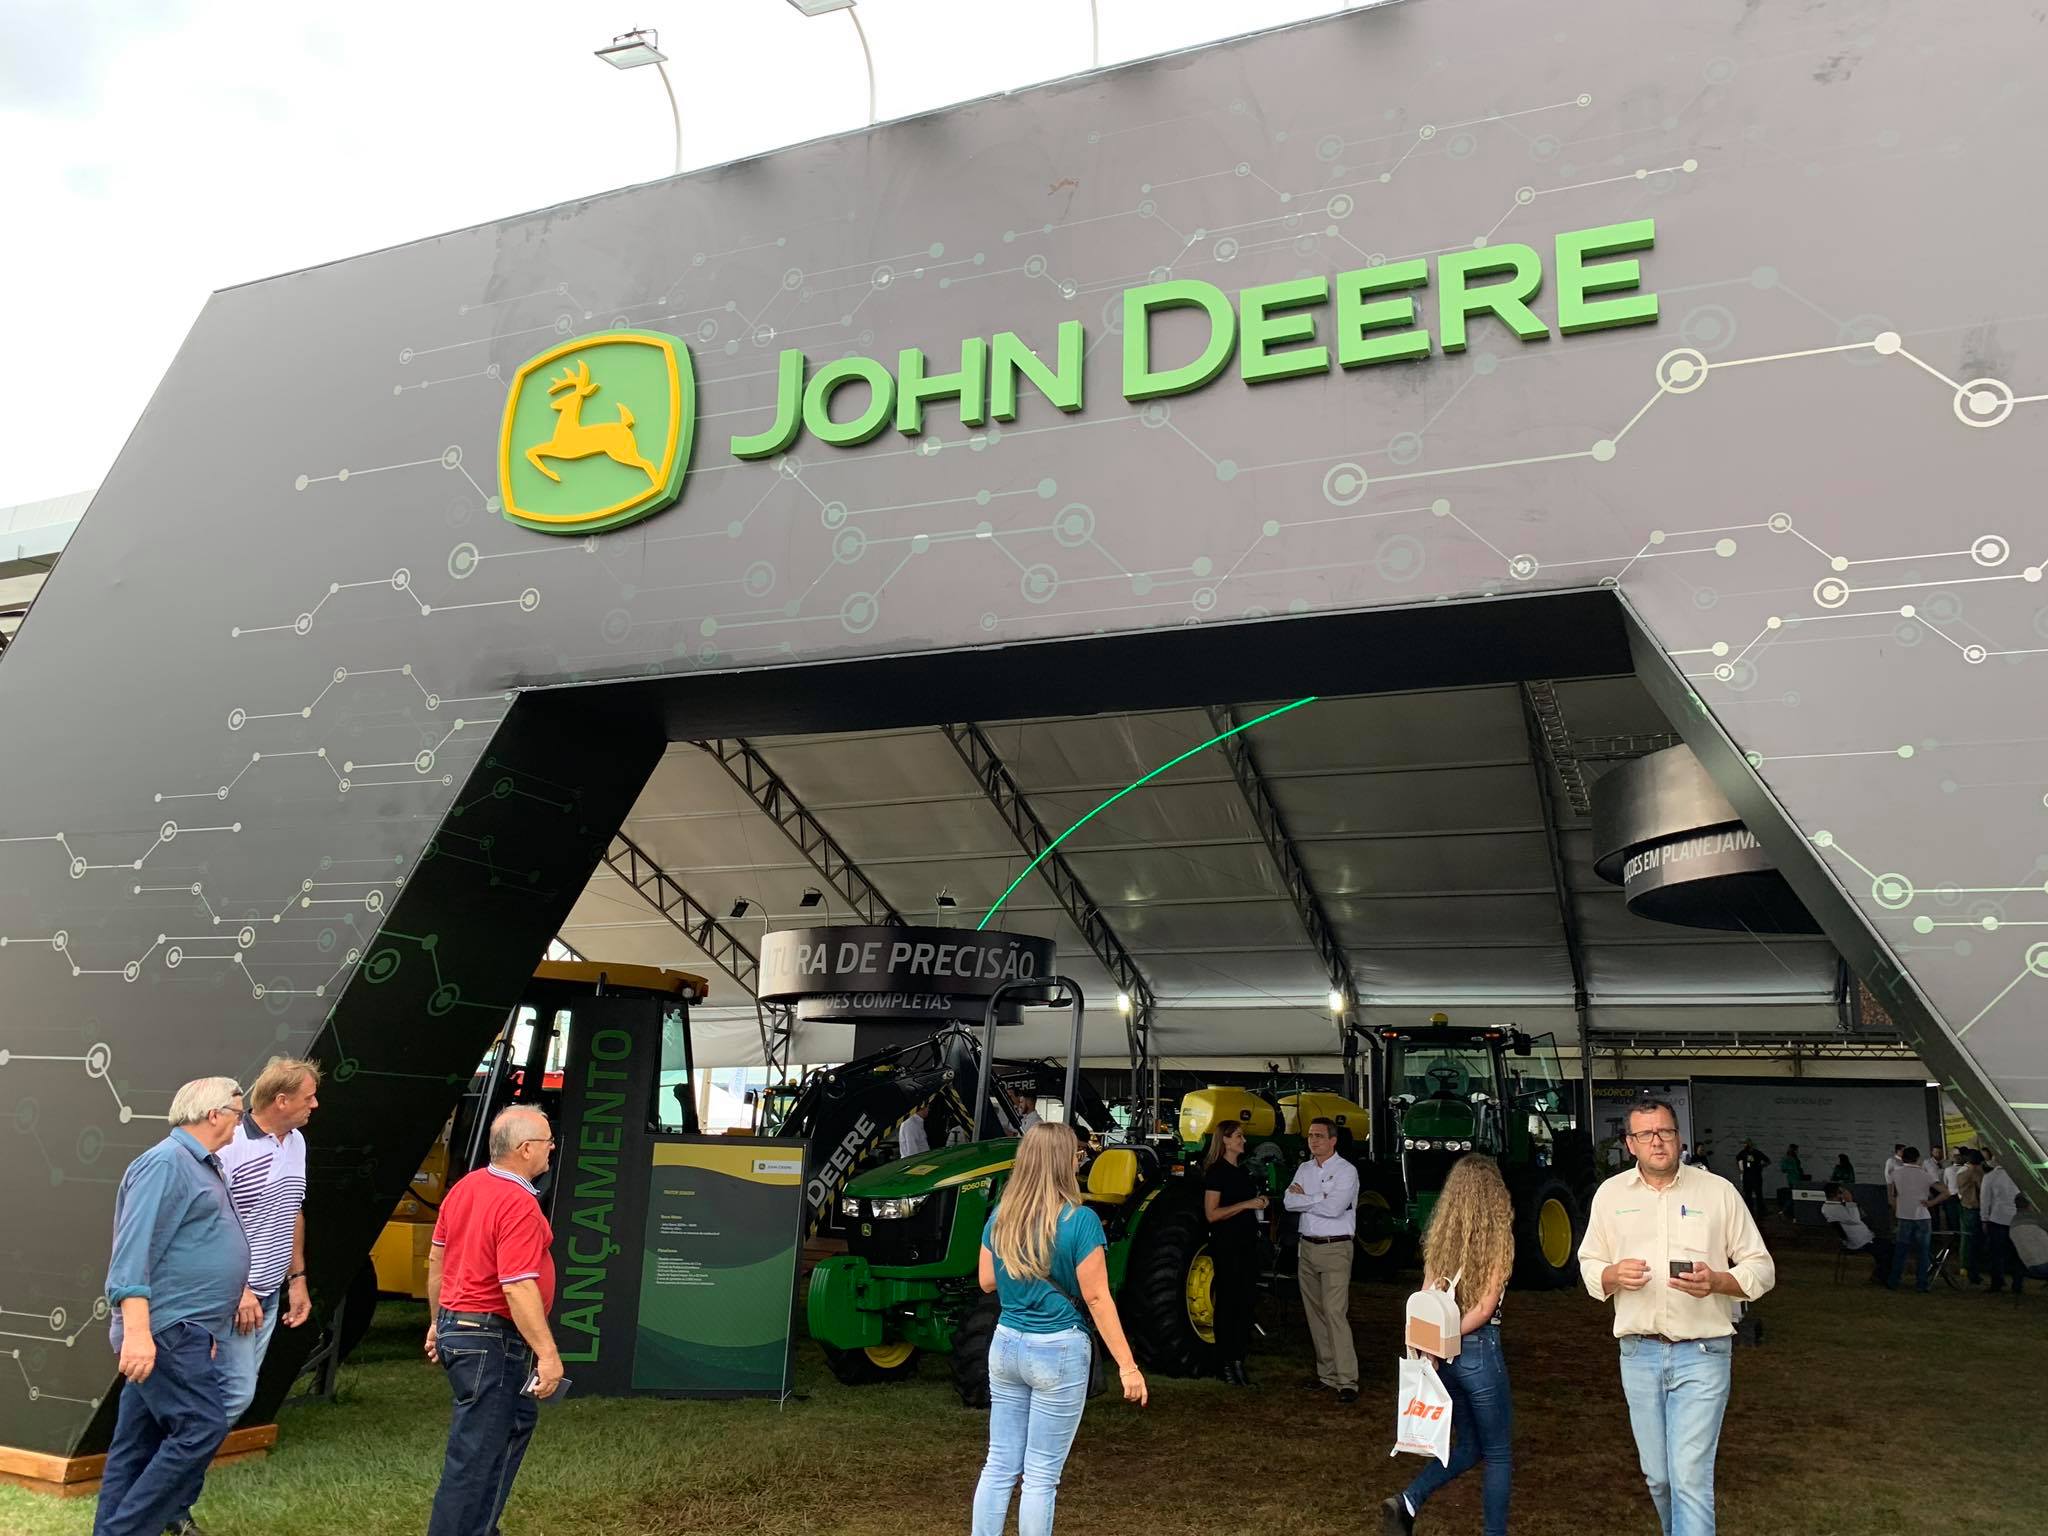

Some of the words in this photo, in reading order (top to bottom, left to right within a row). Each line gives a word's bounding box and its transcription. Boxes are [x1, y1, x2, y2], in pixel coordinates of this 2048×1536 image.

[731, 320, 1083, 461] JOHN
[1123, 218, 1658, 402] DEERE
[1644, 848, 1660, 872] EM
[1661, 830, 1760, 866] PLANEJAM
[836, 942, 881, 975] DE
[887, 940, 1035, 979] PRECISÃO
[853, 992, 952, 1010] COMPLETAS
[806, 1112, 876, 1208] DEERE
[560, 1029, 633, 1362] LANÇAMENTO
